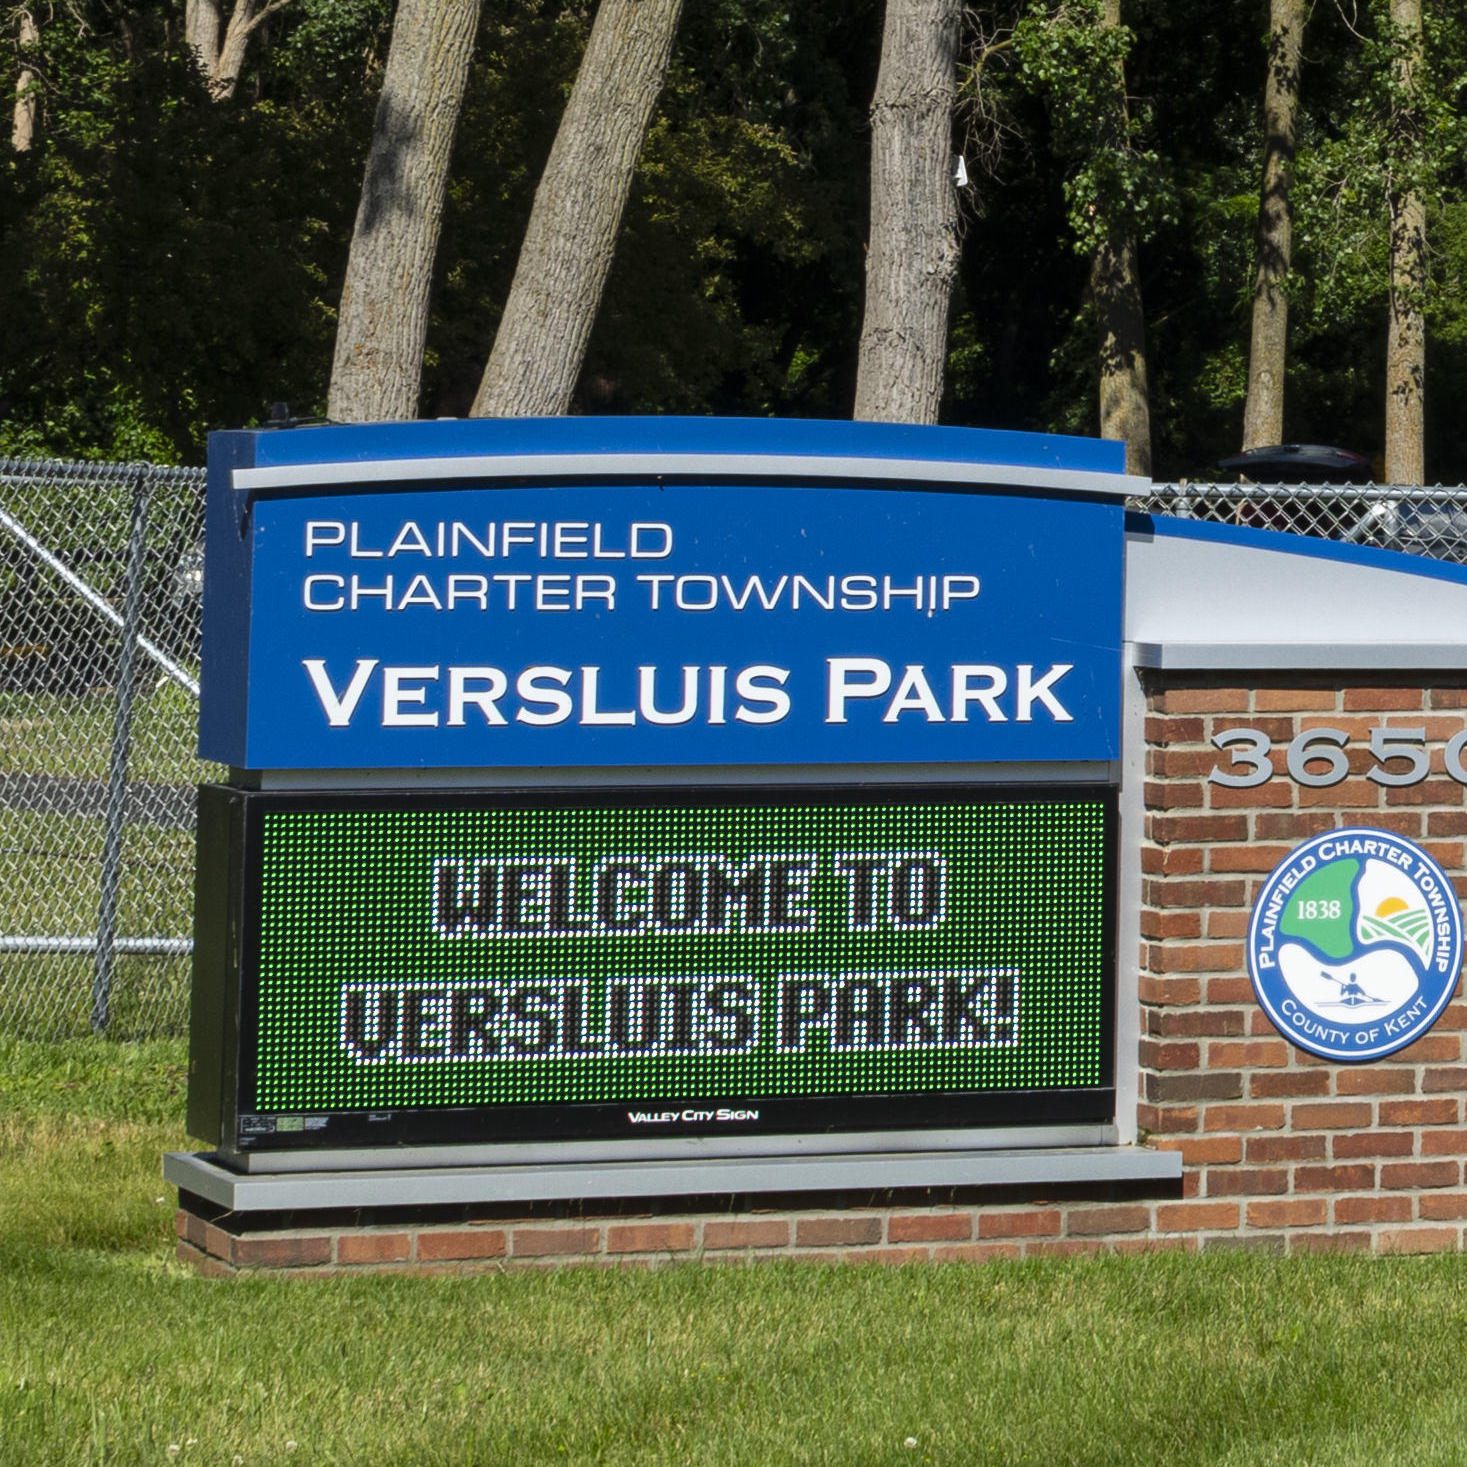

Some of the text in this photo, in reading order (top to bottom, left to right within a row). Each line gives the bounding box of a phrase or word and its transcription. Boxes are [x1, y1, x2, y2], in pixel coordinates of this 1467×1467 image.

[304, 521, 673, 559] PLAINFIELD
[302, 574, 980, 613] CHARTER TOWNSHIP
[301, 657, 1074, 728] VERSLUIS PARK
[433, 851, 946, 940] WELCOME TO
[1259, 839, 1451, 973] PLAINFIELD CHARTER TOWNSHIP
[1297, 899, 1342, 920] 1838
[340, 968, 1021, 1065] VERSLUIS PARK!
[1281, 995, 1429, 1045] COUNTY OF KENT
[627, 1108, 760, 1123] VALLEY CITY SIGN
